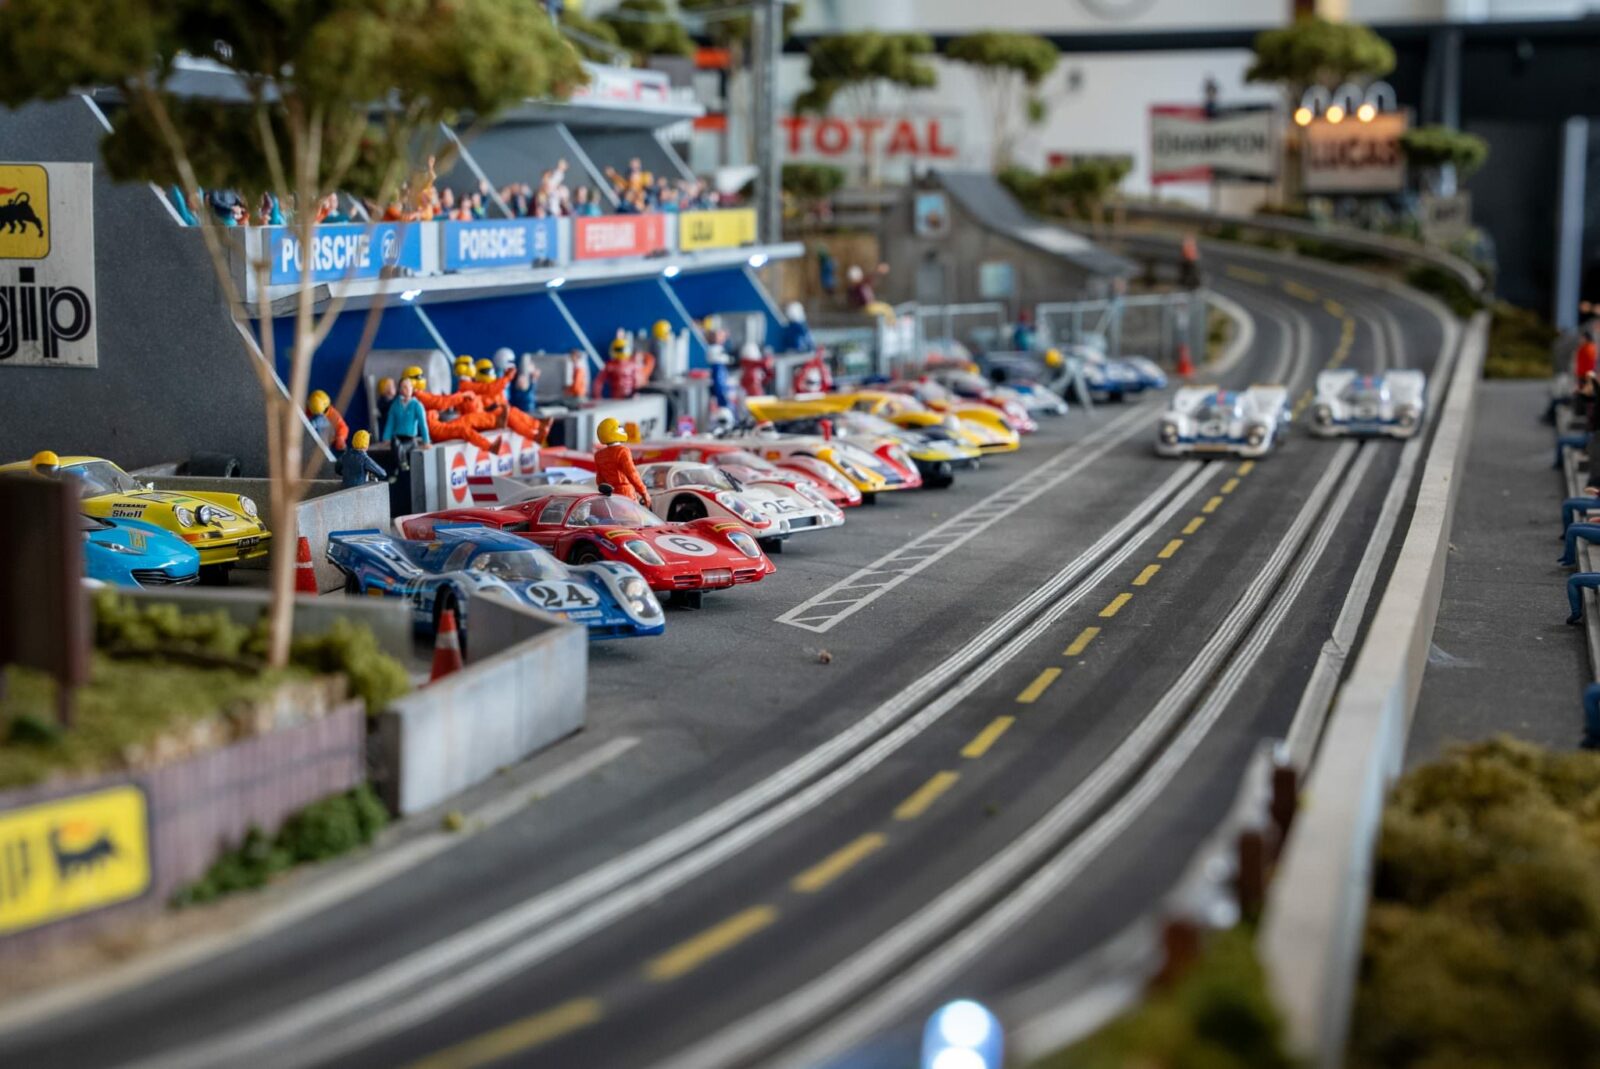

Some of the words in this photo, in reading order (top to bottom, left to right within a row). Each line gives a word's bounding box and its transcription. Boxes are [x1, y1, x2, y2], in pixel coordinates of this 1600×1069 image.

[780, 116, 957, 157] TOTAL
[281, 234, 371, 273] PORSCHE
[459, 226, 526, 261] PORSCHE
[451, 470, 468, 486] Gulf
[112, 509, 143, 518] Shell
[669, 537, 703, 552] 6
[530, 584, 593, 607] 24
